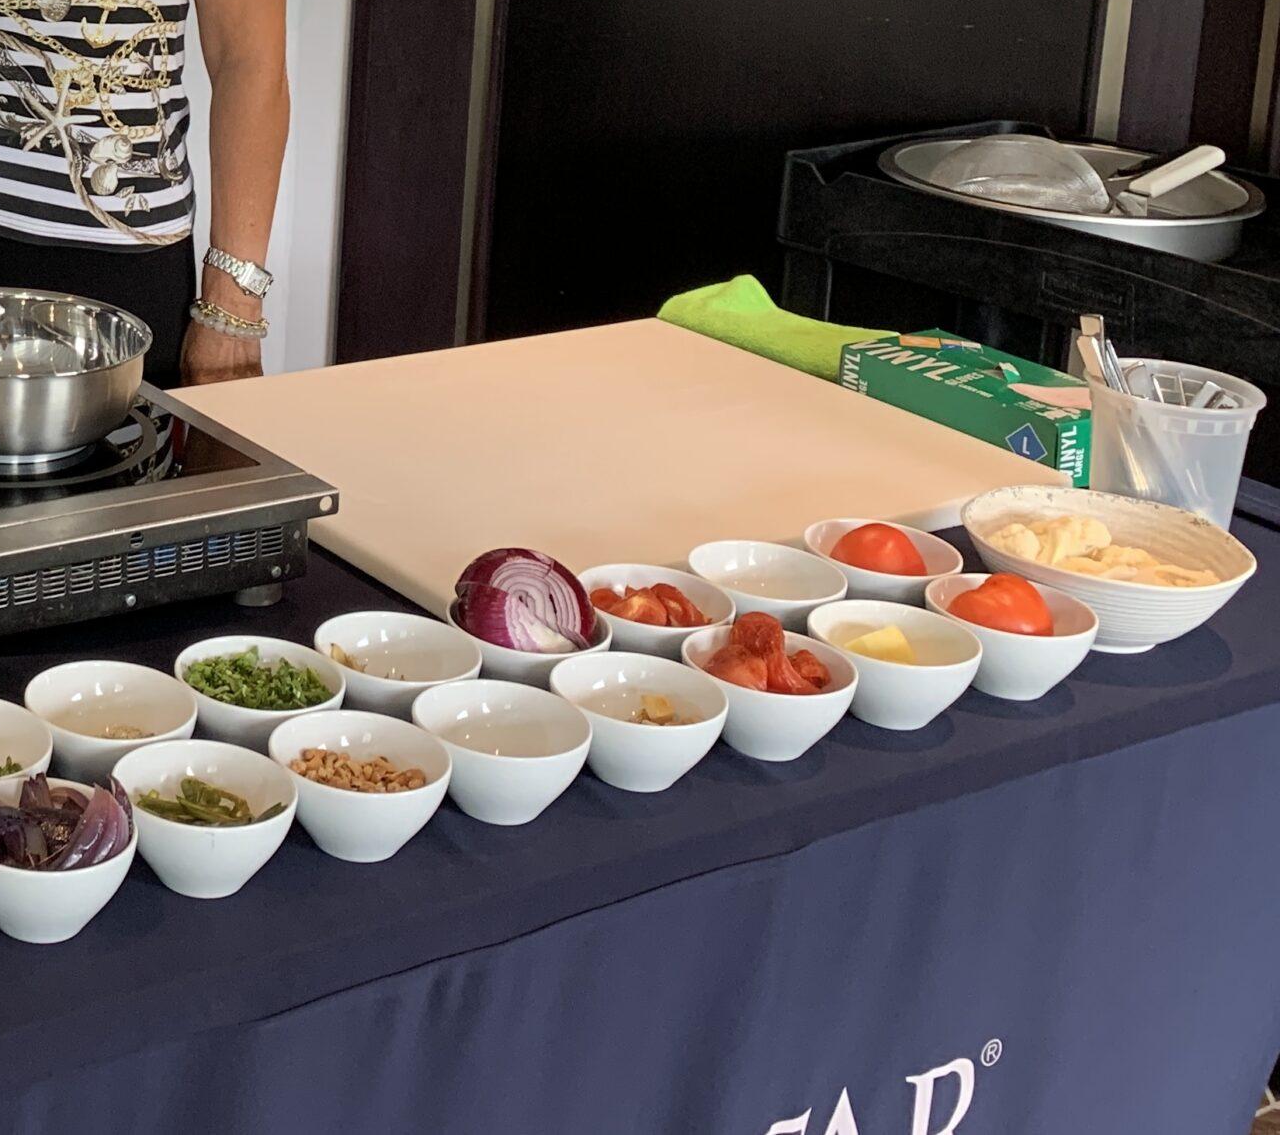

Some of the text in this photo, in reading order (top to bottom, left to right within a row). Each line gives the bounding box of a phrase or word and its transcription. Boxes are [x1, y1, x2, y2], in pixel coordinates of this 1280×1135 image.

[842, 352, 861, 391] INYL
[848, 339, 960, 382] VINYL
[1022, 436, 1030, 455] L
[1073, 448, 1084, 478] LARGE
